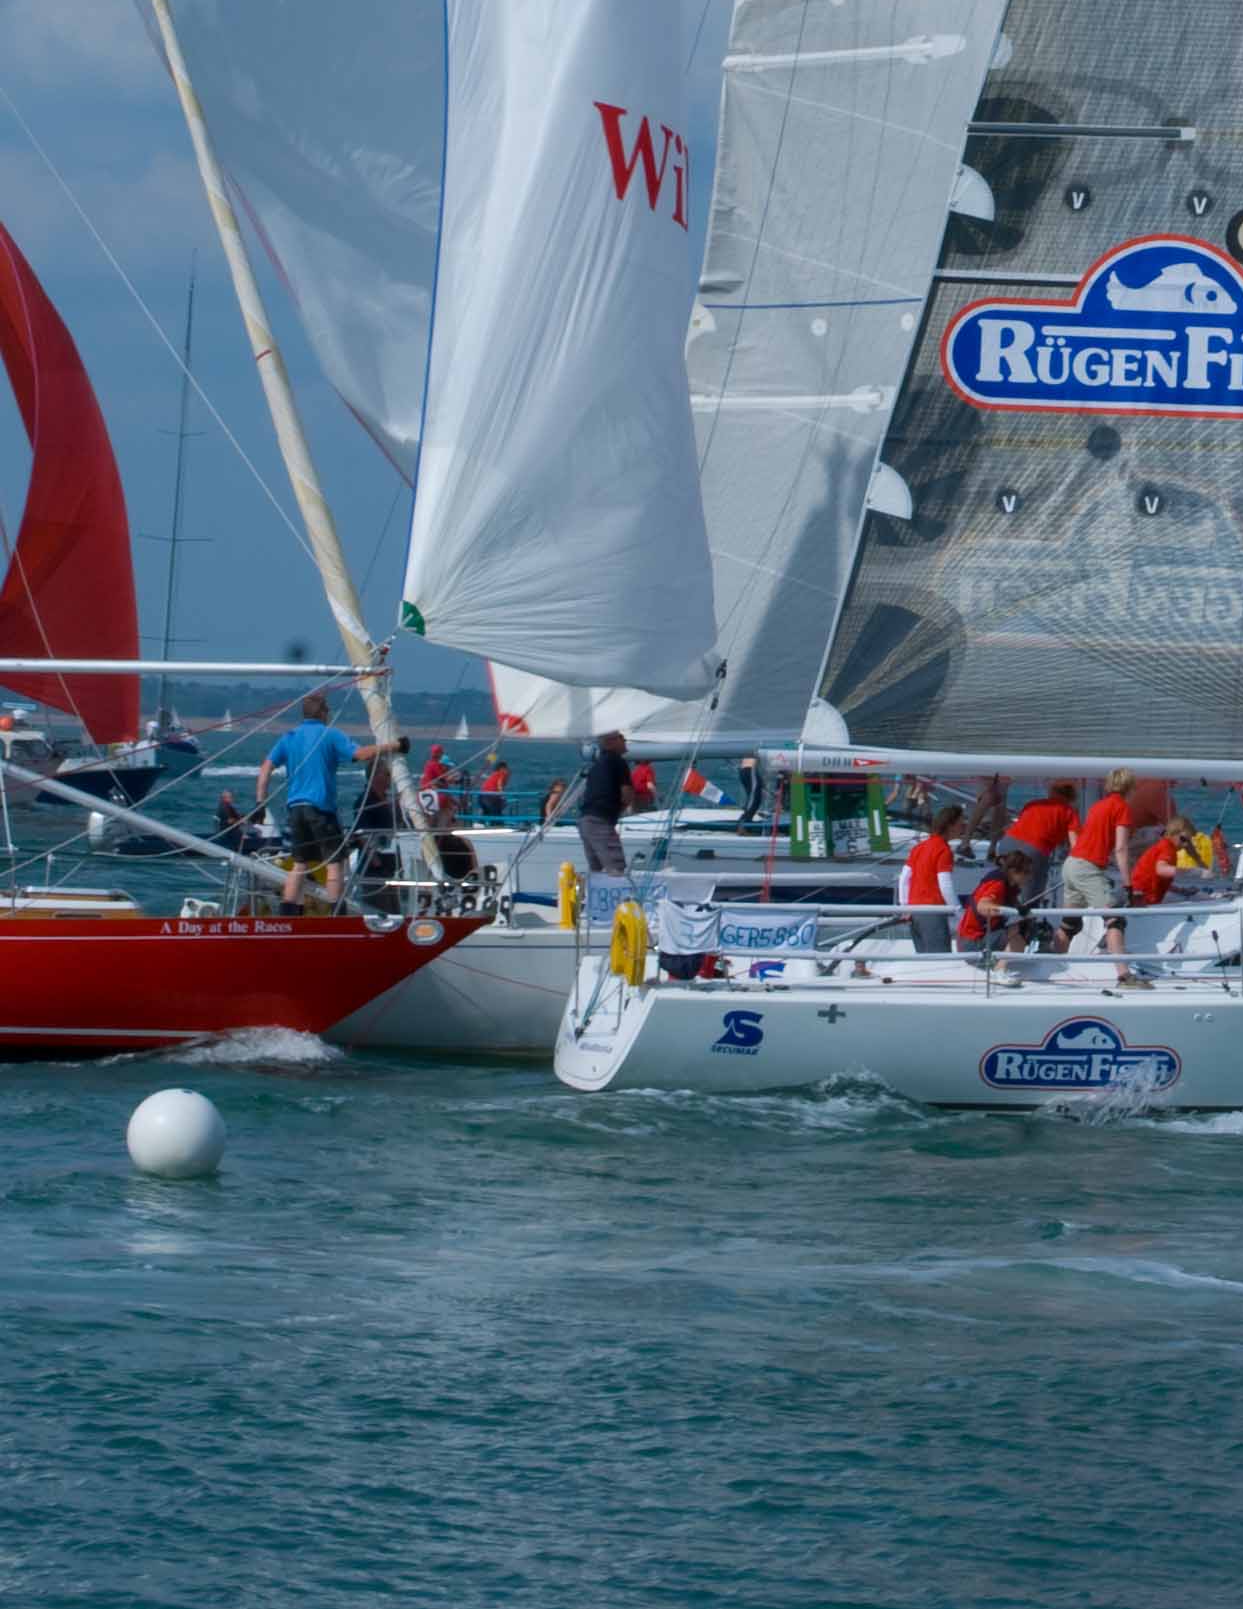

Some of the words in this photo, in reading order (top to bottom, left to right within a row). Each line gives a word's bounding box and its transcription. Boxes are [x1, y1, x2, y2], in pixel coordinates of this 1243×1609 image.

[160, 921, 172, 933] A
[179, 919, 202, 936] Day
[209, 922, 222, 933] at
[228, 920, 248, 933] the
[254, 919, 293, 933] Races
